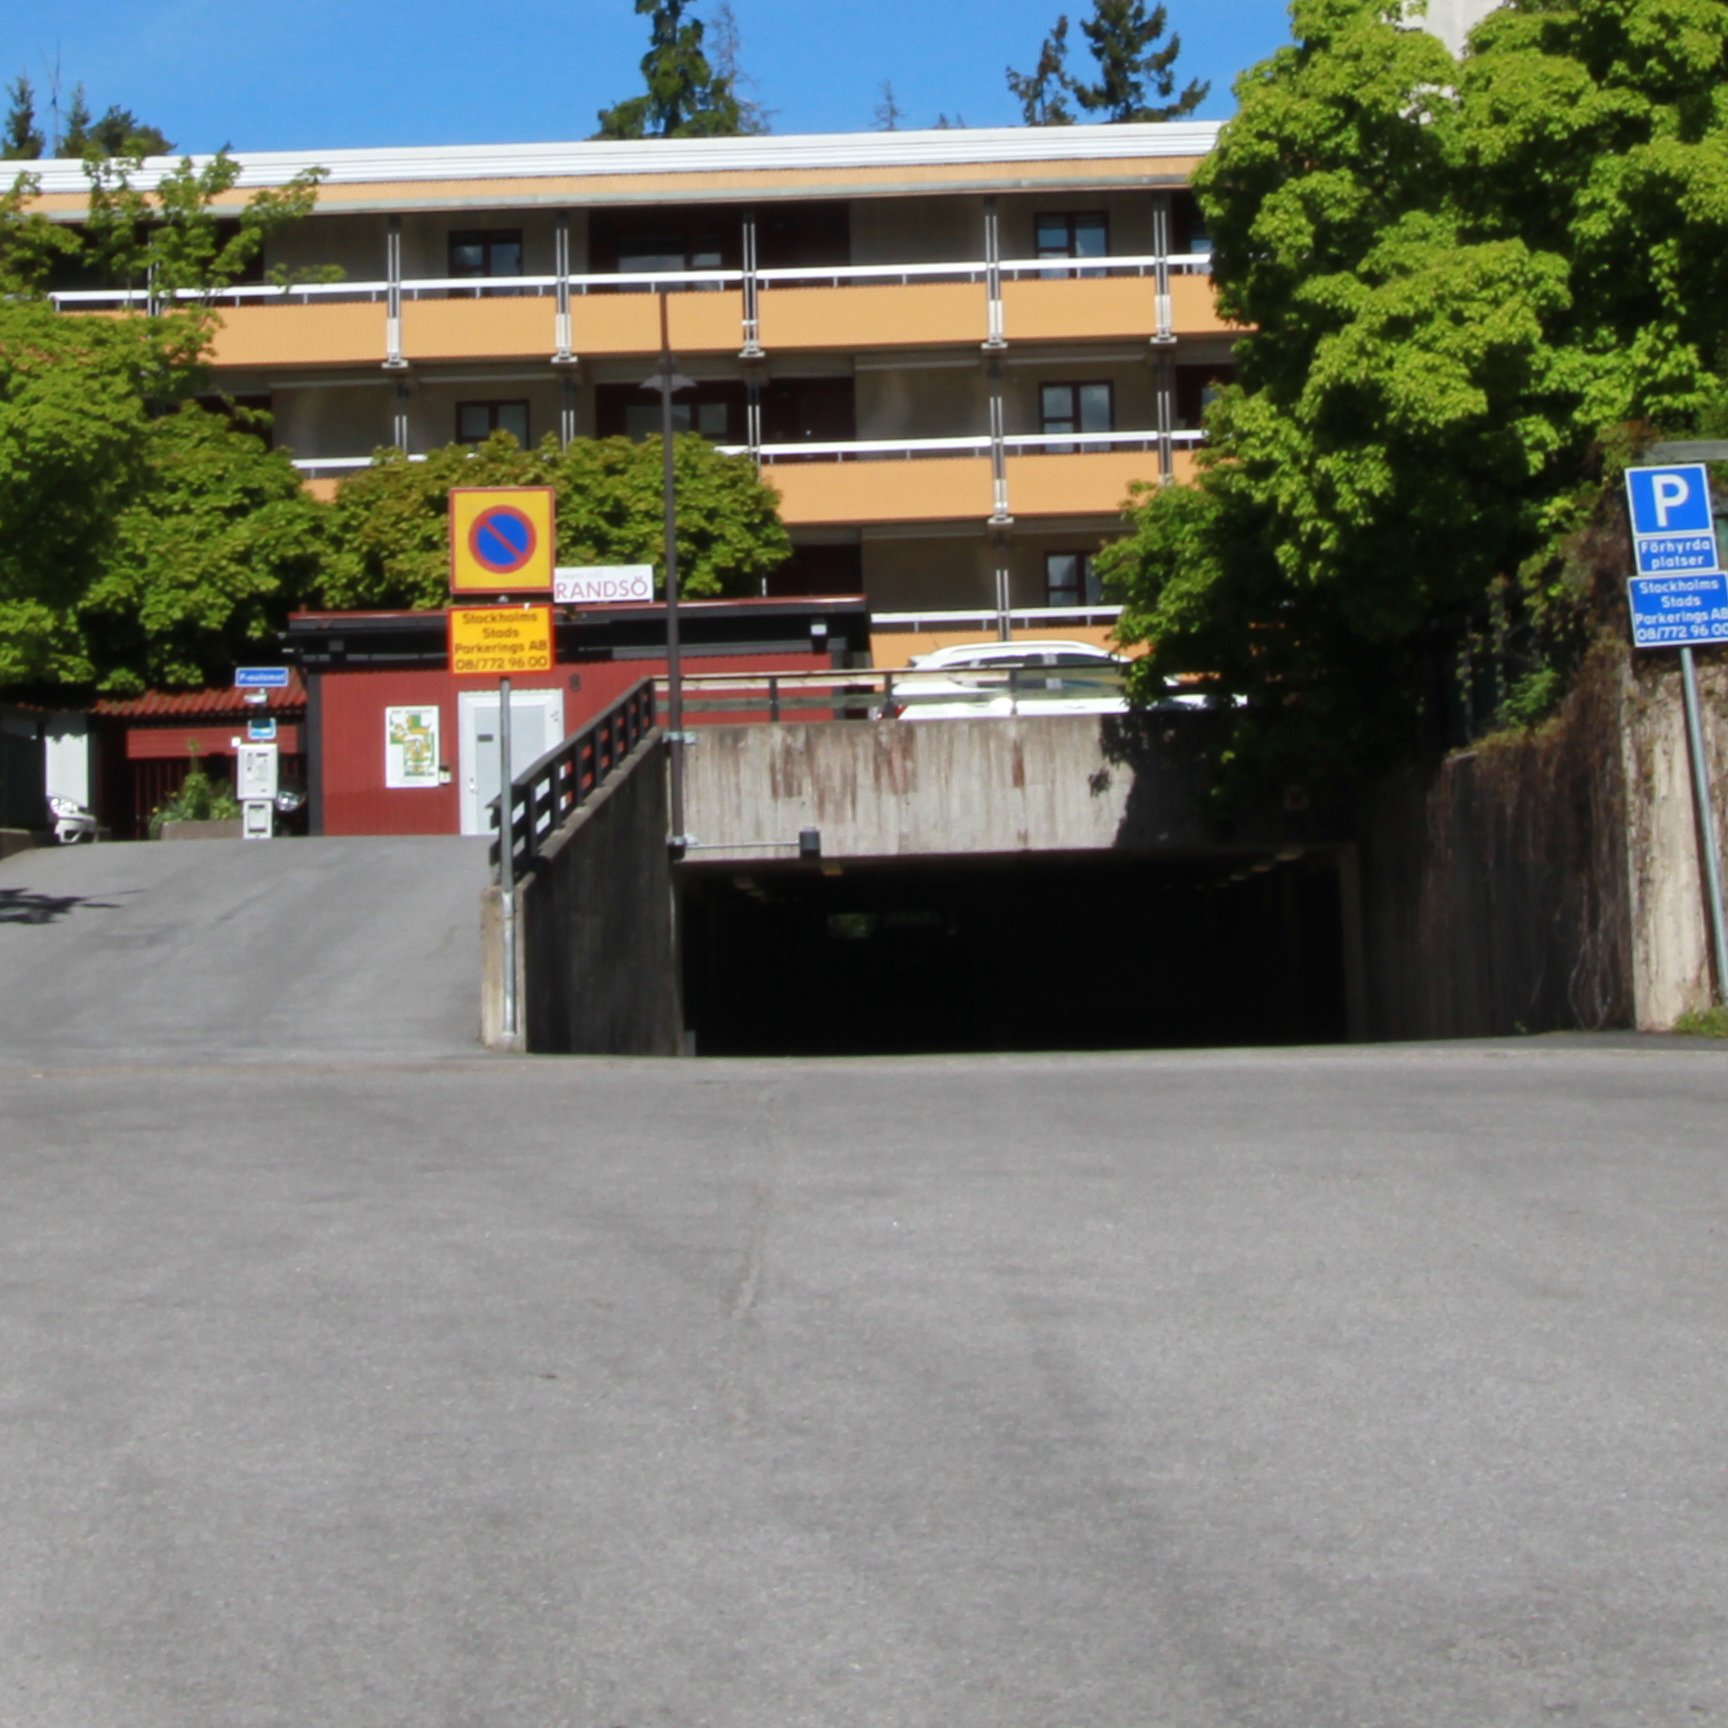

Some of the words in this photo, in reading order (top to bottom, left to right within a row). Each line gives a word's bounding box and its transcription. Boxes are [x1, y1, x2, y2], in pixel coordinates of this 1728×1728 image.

[1651, 474, 1690, 528] P
[1641, 538, 1711, 554] Förhyrda
[1651, 555, 1705, 570] platser
[1639, 579, 1720, 595] Stockholms
[1660, 595, 1702, 609] Stads
[462, 612, 538, 624] Stockholms
[1635, 611, 1709, 626] Parkerings
[483, 626, 520, 639] Stads
[1636, 626, 1687, 642] 08/772
[1690, 624, 1708, 637] 96
[455, 642, 525, 655] Parkerings
[529, 640, 548, 651] AB
[455, 657, 505, 671] 08/772
[507, 657, 525, 668] 96
[527, 655, 548, 668] 00
